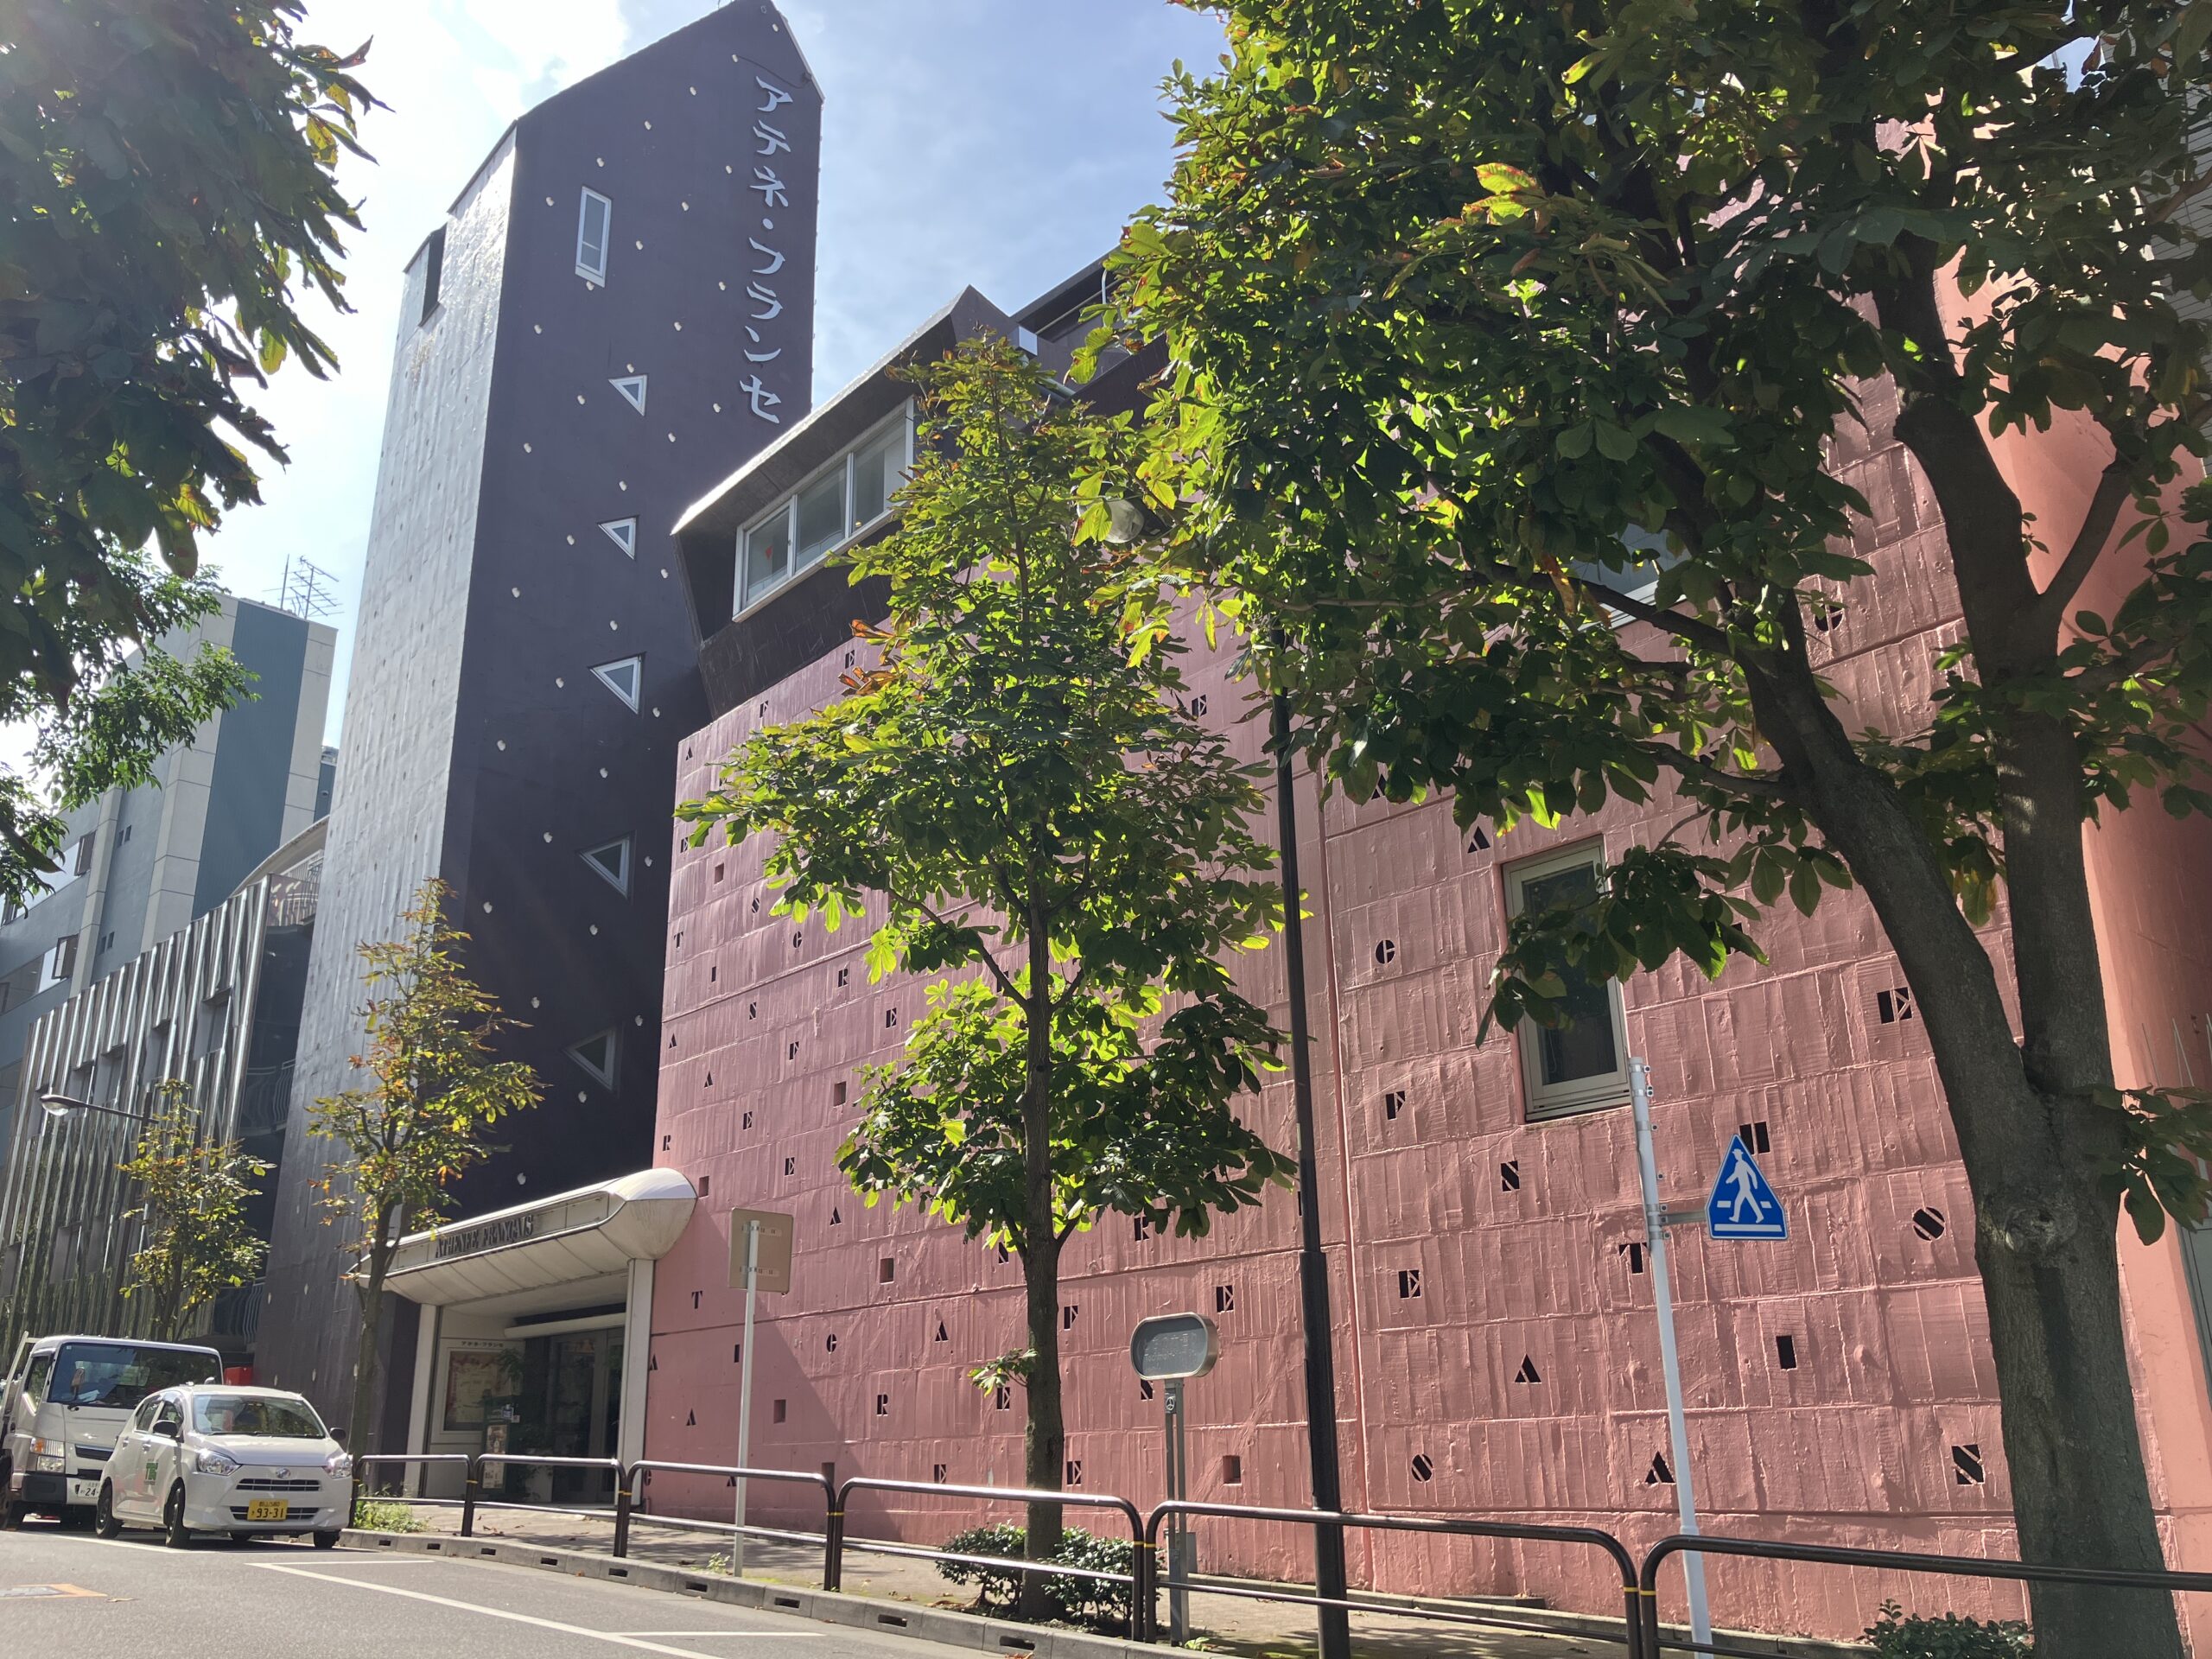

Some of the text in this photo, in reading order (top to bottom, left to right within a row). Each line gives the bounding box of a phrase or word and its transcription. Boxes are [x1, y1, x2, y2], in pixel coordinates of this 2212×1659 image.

[740, 76, 792, 423] アテネ・フランセ
